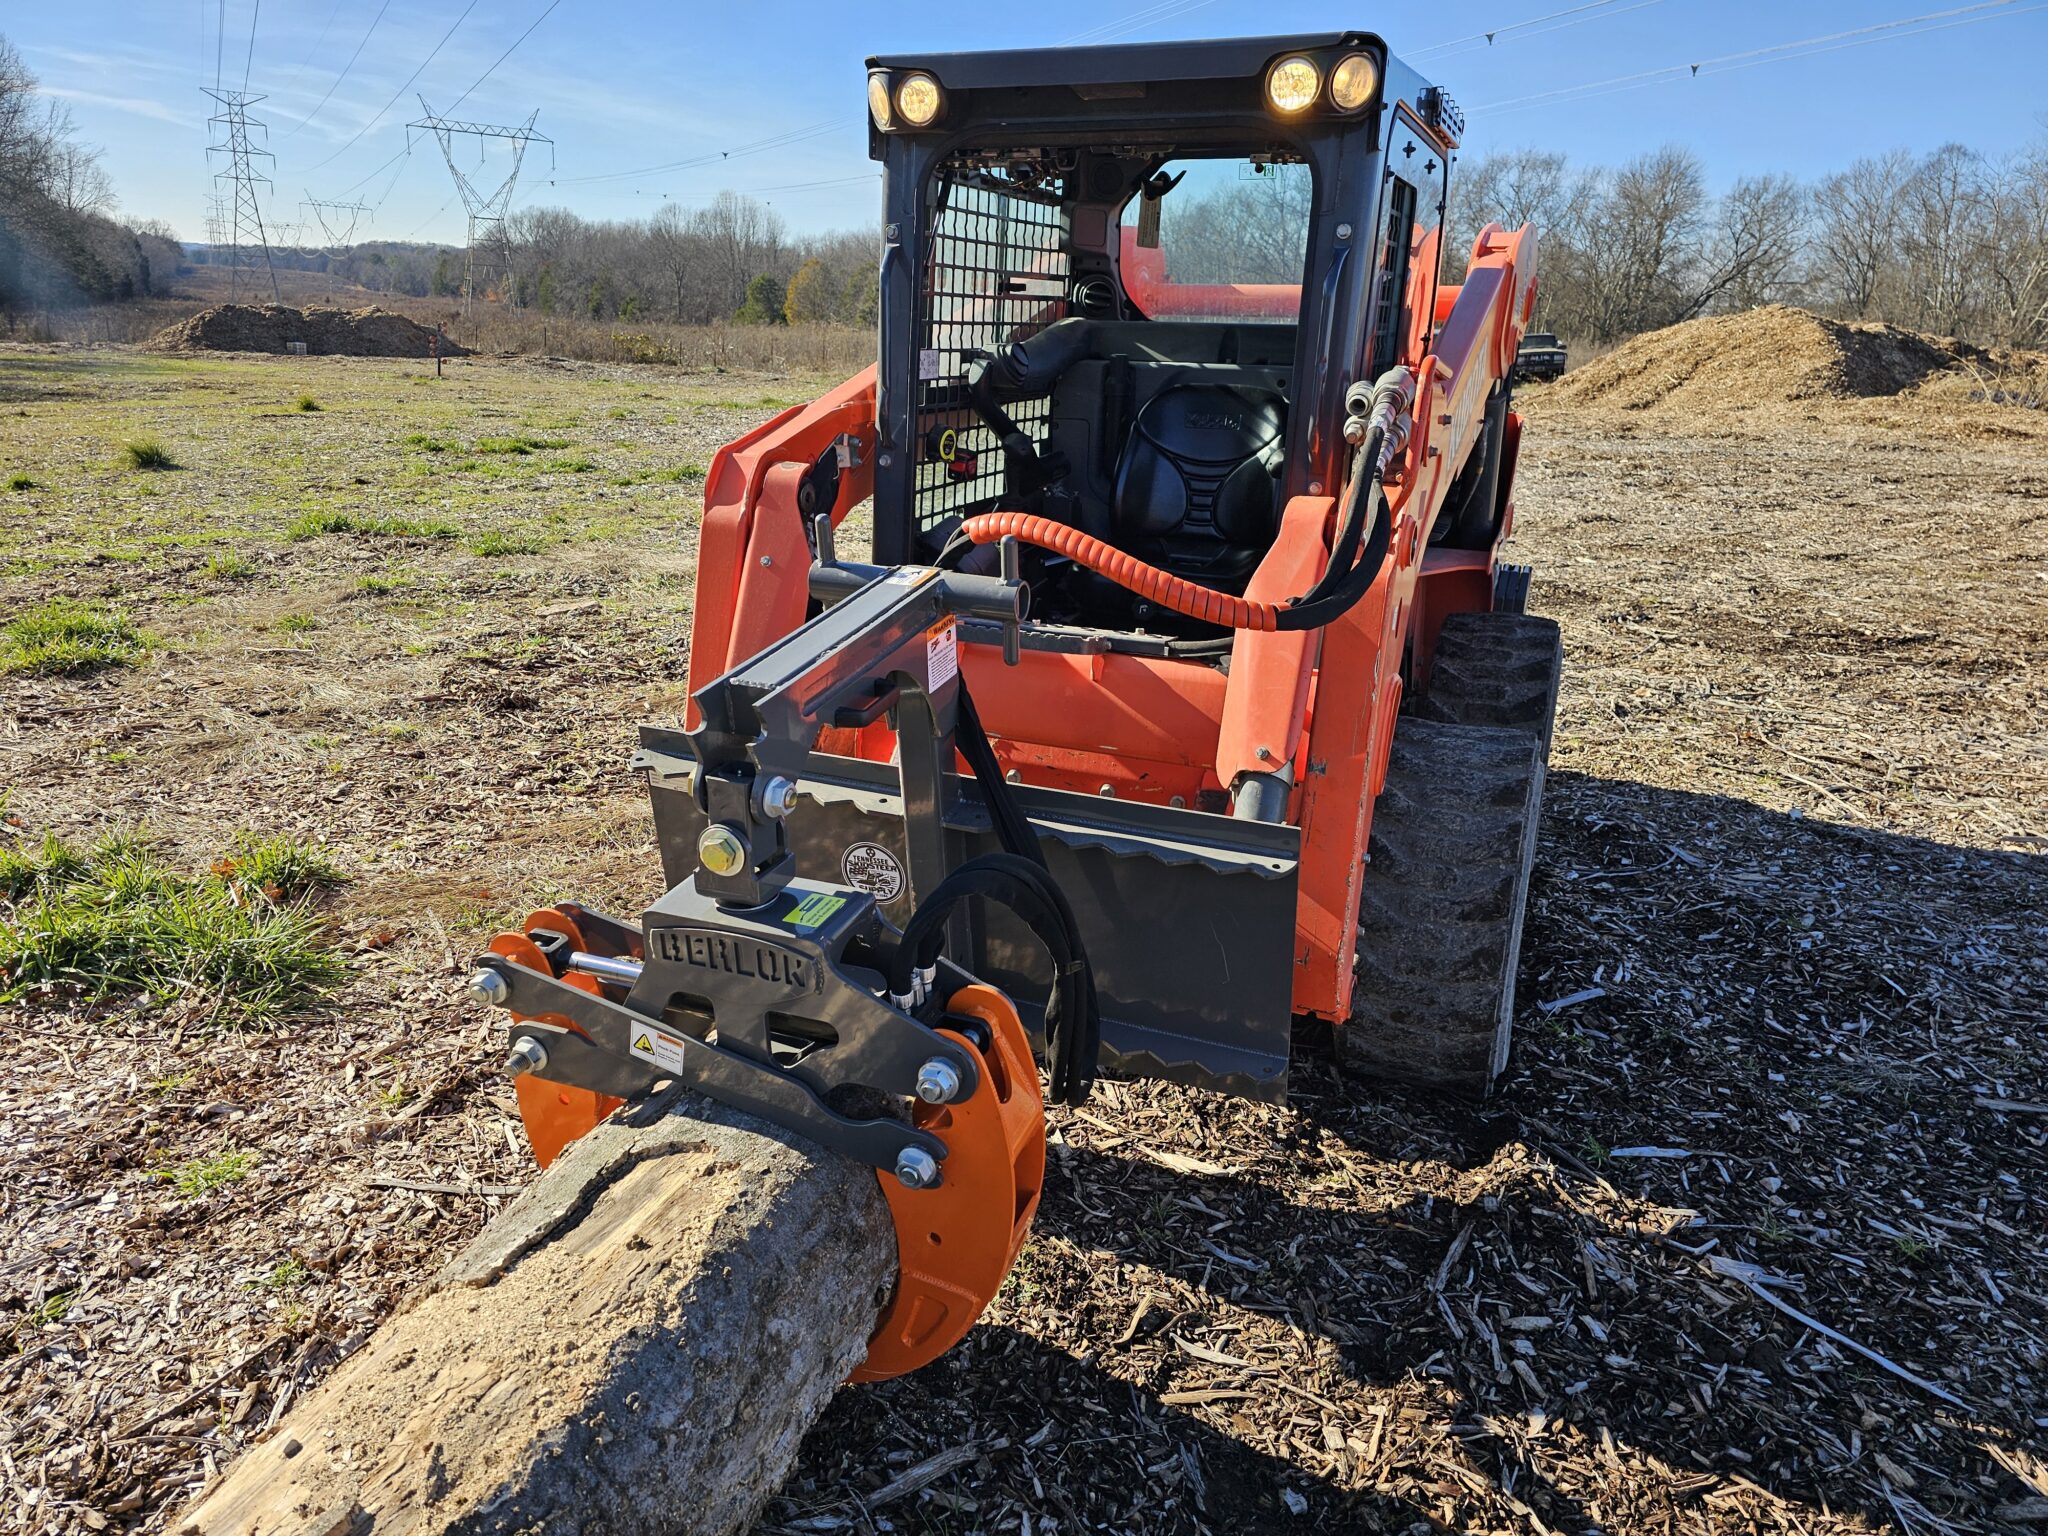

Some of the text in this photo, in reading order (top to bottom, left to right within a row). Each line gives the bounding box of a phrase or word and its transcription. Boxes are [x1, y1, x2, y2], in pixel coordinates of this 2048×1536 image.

[933, 615, 956, 635] WARNING
[848, 860, 898, 872] SKIDSTEER
[853, 855, 888, 866] TENNESSEE
[660, 933, 806, 987] BERLON
